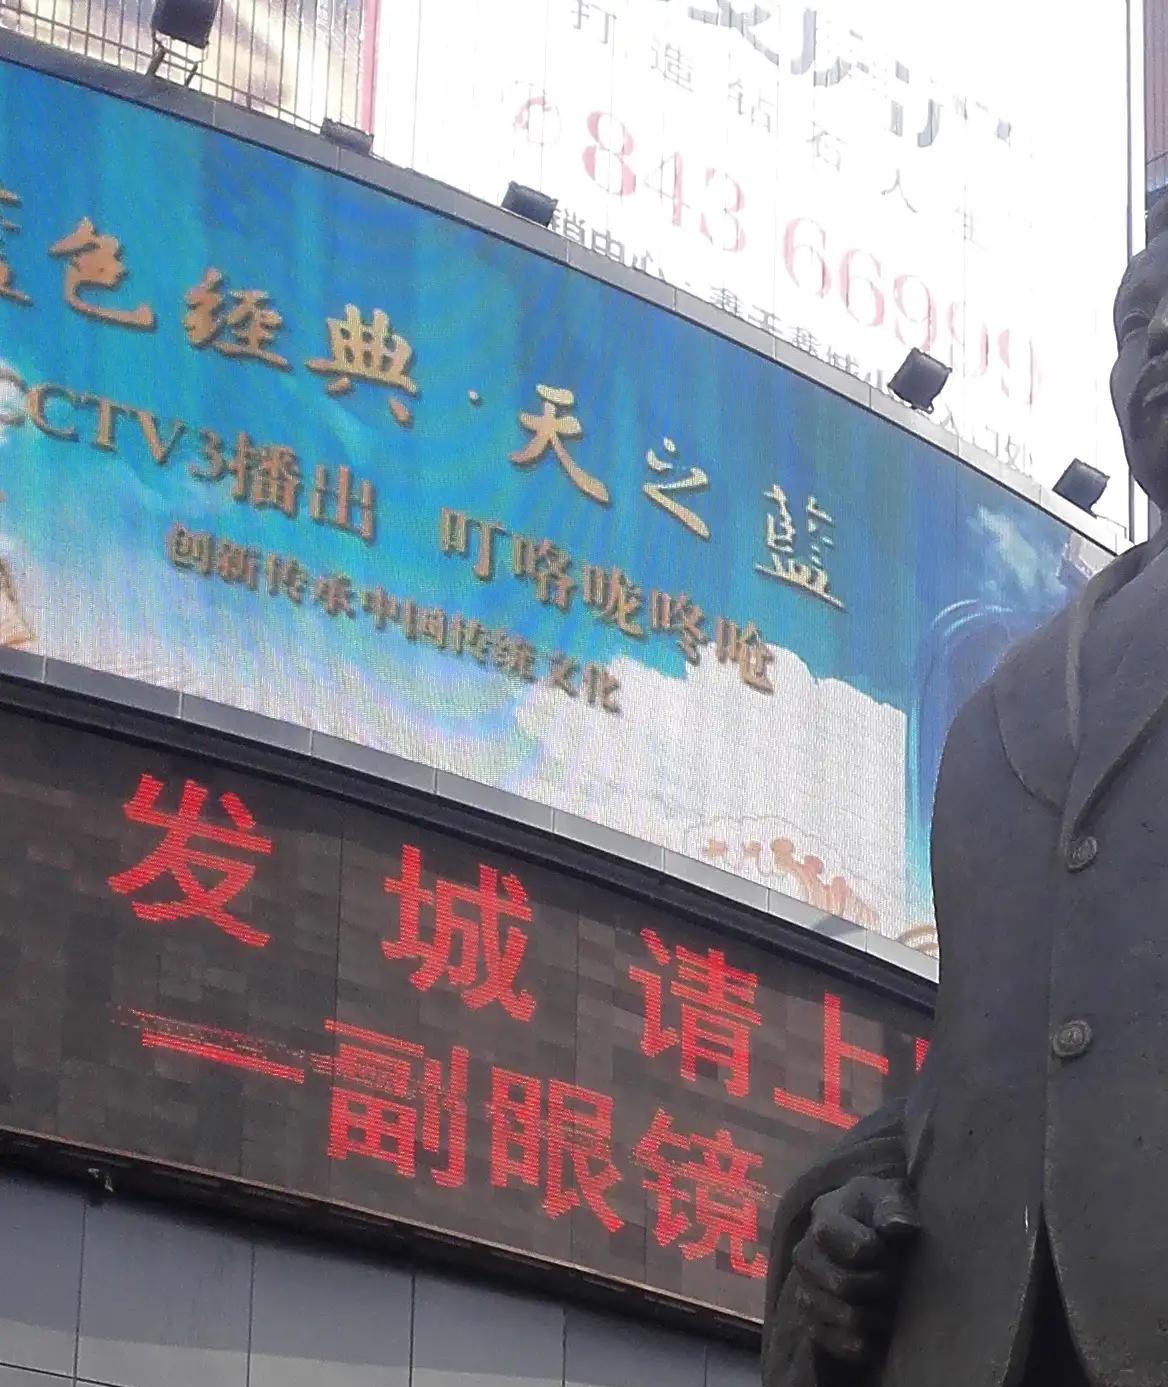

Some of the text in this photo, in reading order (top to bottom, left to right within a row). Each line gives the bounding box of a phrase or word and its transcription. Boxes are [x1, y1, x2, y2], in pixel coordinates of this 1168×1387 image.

[582, 110, 747, 252] 843
[141, 1016, 769, 1279] 一副眼镜
